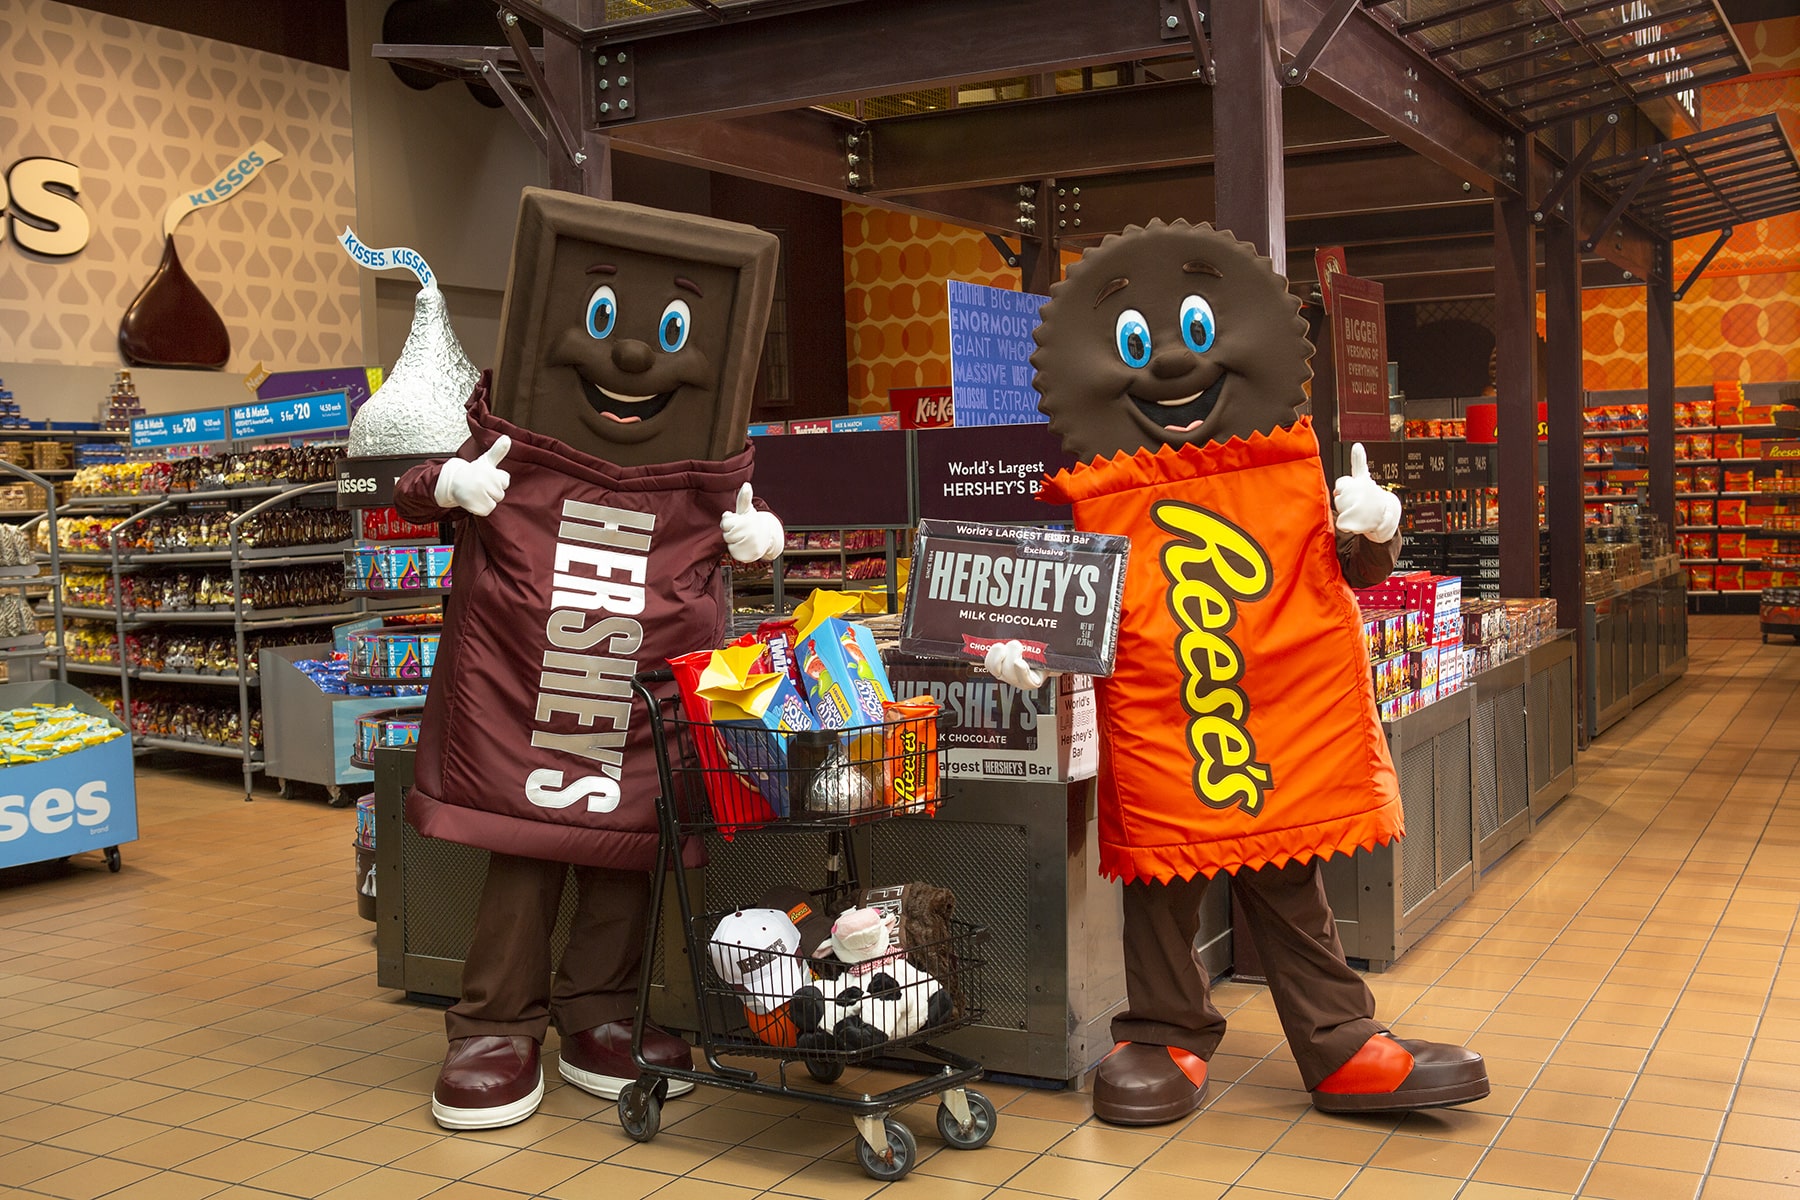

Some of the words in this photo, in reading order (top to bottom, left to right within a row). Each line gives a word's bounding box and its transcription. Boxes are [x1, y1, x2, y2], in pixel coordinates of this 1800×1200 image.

[991, 288, 1011, 311] BIG
[1015, 293, 1046, 314] MON
[952, 309, 1028, 338] ENORMOUS
[1345, 317, 1378, 344] BIGGER
[953, 334, 991, 358] GIANT
[997, 339, 1036, 362] WHOP
[1347, 344, 1371, 360] VERSIONS
[1372, 349, 1379, 360] OF
[955, 362, 1007, 385] MASSIVE
[1012, 365, 1028, 387] VAST
[1349, 363, 1379, 378] EVERYTHING
[1352, 381, 1362, 394] YOU
[955, 387, 988, 410] COLOSSAL
[993, 390, 1041, 412] EXTRAV
[234, 408, 245, 420] Mix
[251, 405, 269, 417] Match
[285, 411, 294, 421] for
[294, 402, 310, 420] $20
[915, 397, 953, 423] KitKa
[183, 417, 196, 433] $20
[948, 460, 994, 476] World's
[998, 460, 1045, 478] Largest
[943, 479, 1025, 497] HERSHEY'S
[1030, 481, 1044, 495] Ba
[956, 525, 993, 538] World's
[995, 528, 1042, 541] LARGEST
[1072, 535, 1090, 545] Bar
[1480, 535, 1499, 545] HERSH
[1024, 546, 1064, 557] Exclusive
[1480, 559, 1499, 567] HERSH
[1480, 569, 1499, 578] HERSH
[928, 550, 1100, 617] HERSHEY'S
[959, 609, 986, 621] MILK
[988, 612, 1058, 629] CHOCOLATE
[525, 499, 657, 813] HERSHEY'S
[1022, 645, 1042, 655] ORLD
[1153, 502, 1270, 813] Reese's
[1065, 696, 1090, 710] World's
[784, 700, 810, 731] JOLLY
[949, 733, 1007, 744] CHOCOLATE
[1061, 729, 1092, 746] Hershey's
[1072, 747, 1084, 758] Bar
[894, 730, 916, 801] Reese's
[939, 761, 980, 773] argest
[984, 761, 1024, 775] HERSHEY'S
[1029, 764, 1052, 775] Bar
